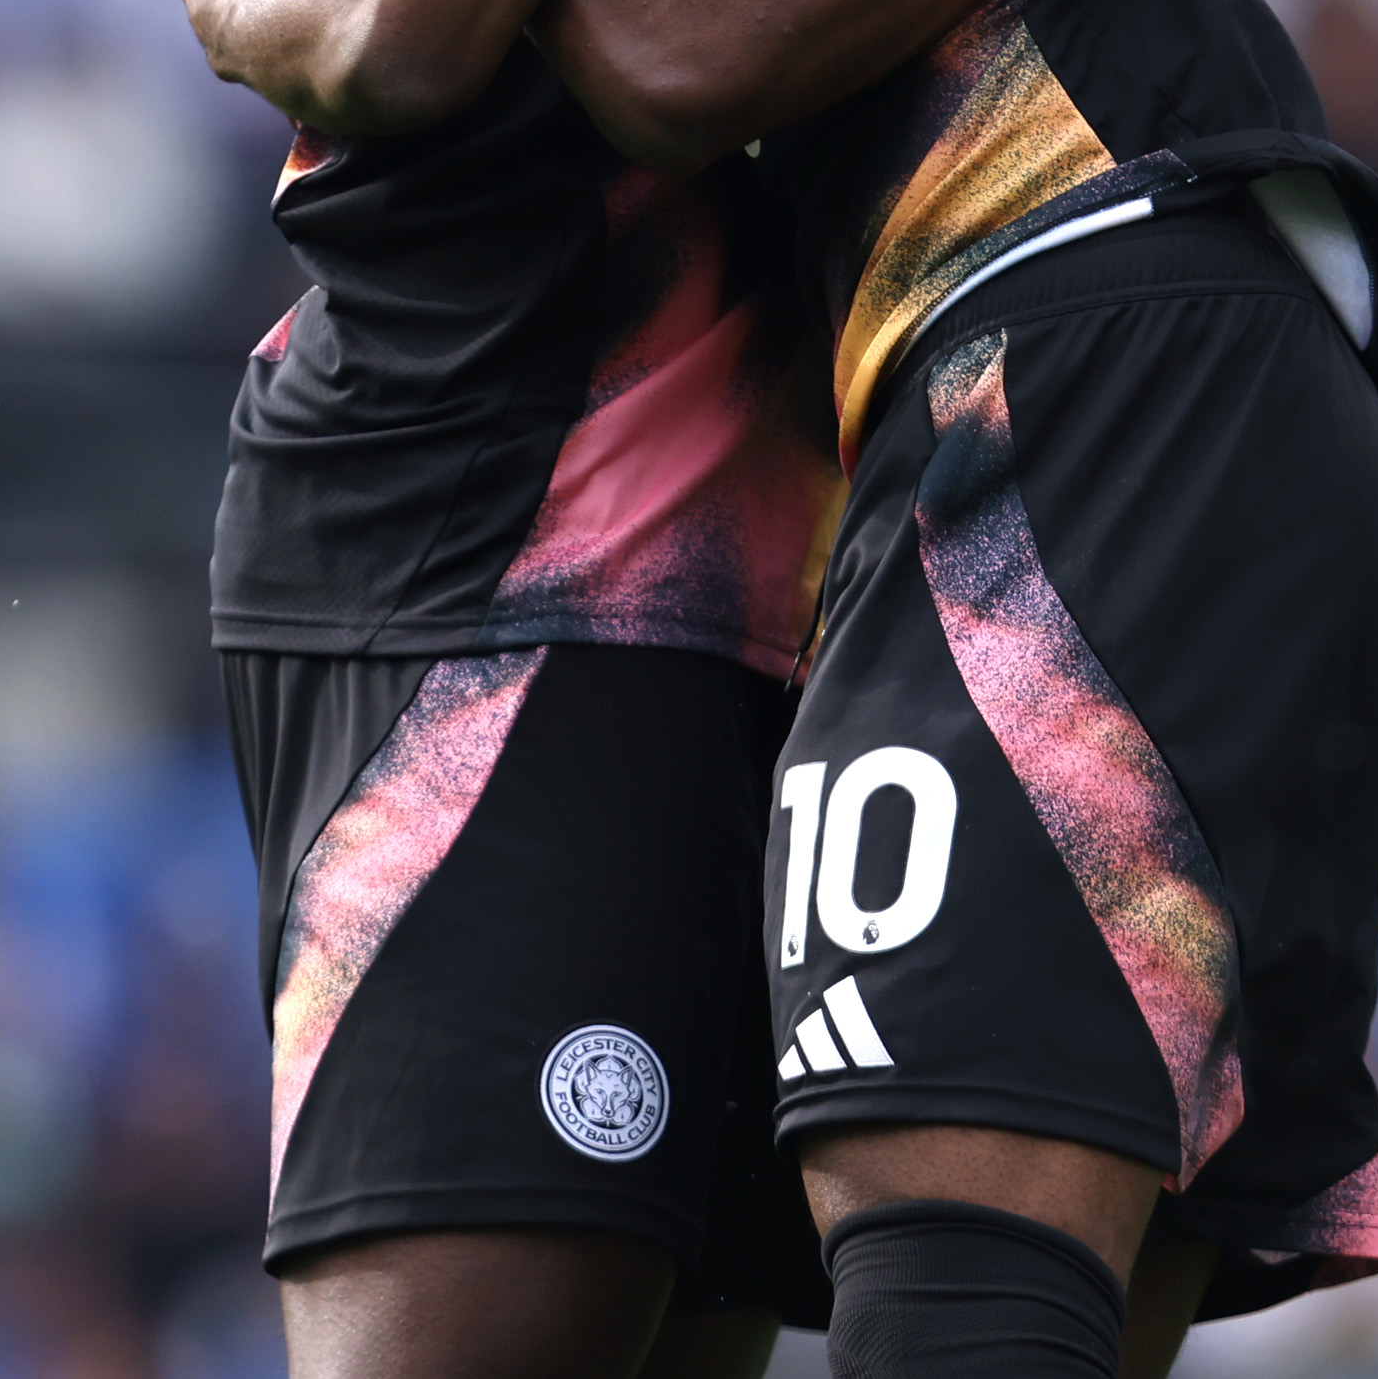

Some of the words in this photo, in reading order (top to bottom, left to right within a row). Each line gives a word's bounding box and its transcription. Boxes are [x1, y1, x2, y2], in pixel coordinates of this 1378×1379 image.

[780, 745, 958, 971] 10
[556, 1038, 637, 1082] LEICESTER
[636, 1057, 658, 1096] CITY
[555, 1090, 627, 1145] FOOTBALL
[627, 1103, 656, 1141] CLUB
